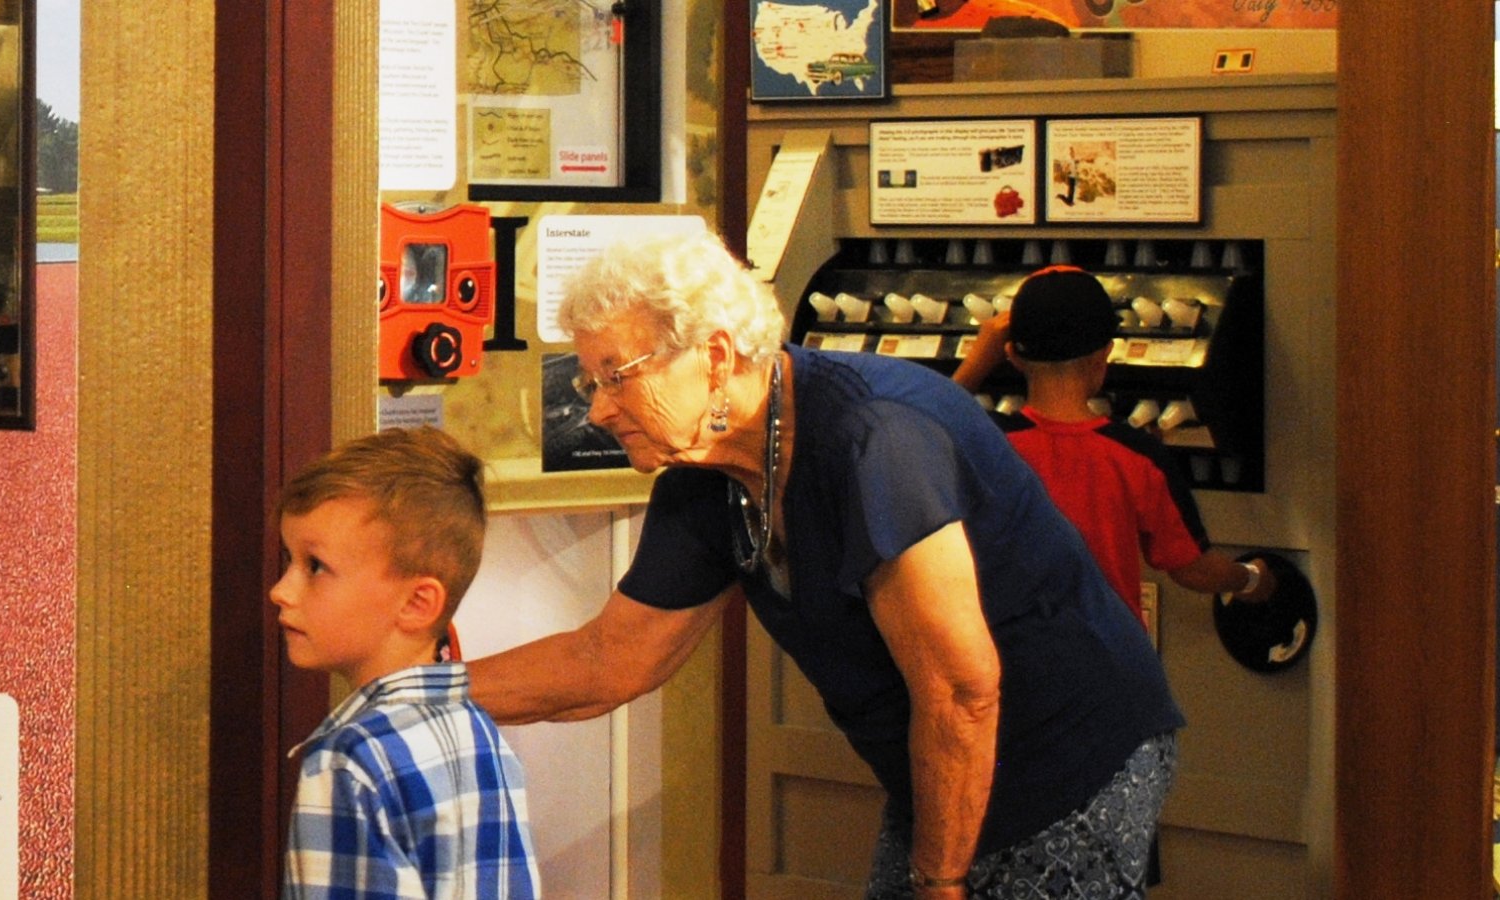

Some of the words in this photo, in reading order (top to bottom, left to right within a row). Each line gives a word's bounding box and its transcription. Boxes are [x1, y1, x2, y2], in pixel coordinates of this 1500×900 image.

[559, 150, 579, 162] Slide
[581, 151, 608, 166] panels
[546, 228, 591, 237] Interstate
[483, 217, 529, 351] I
